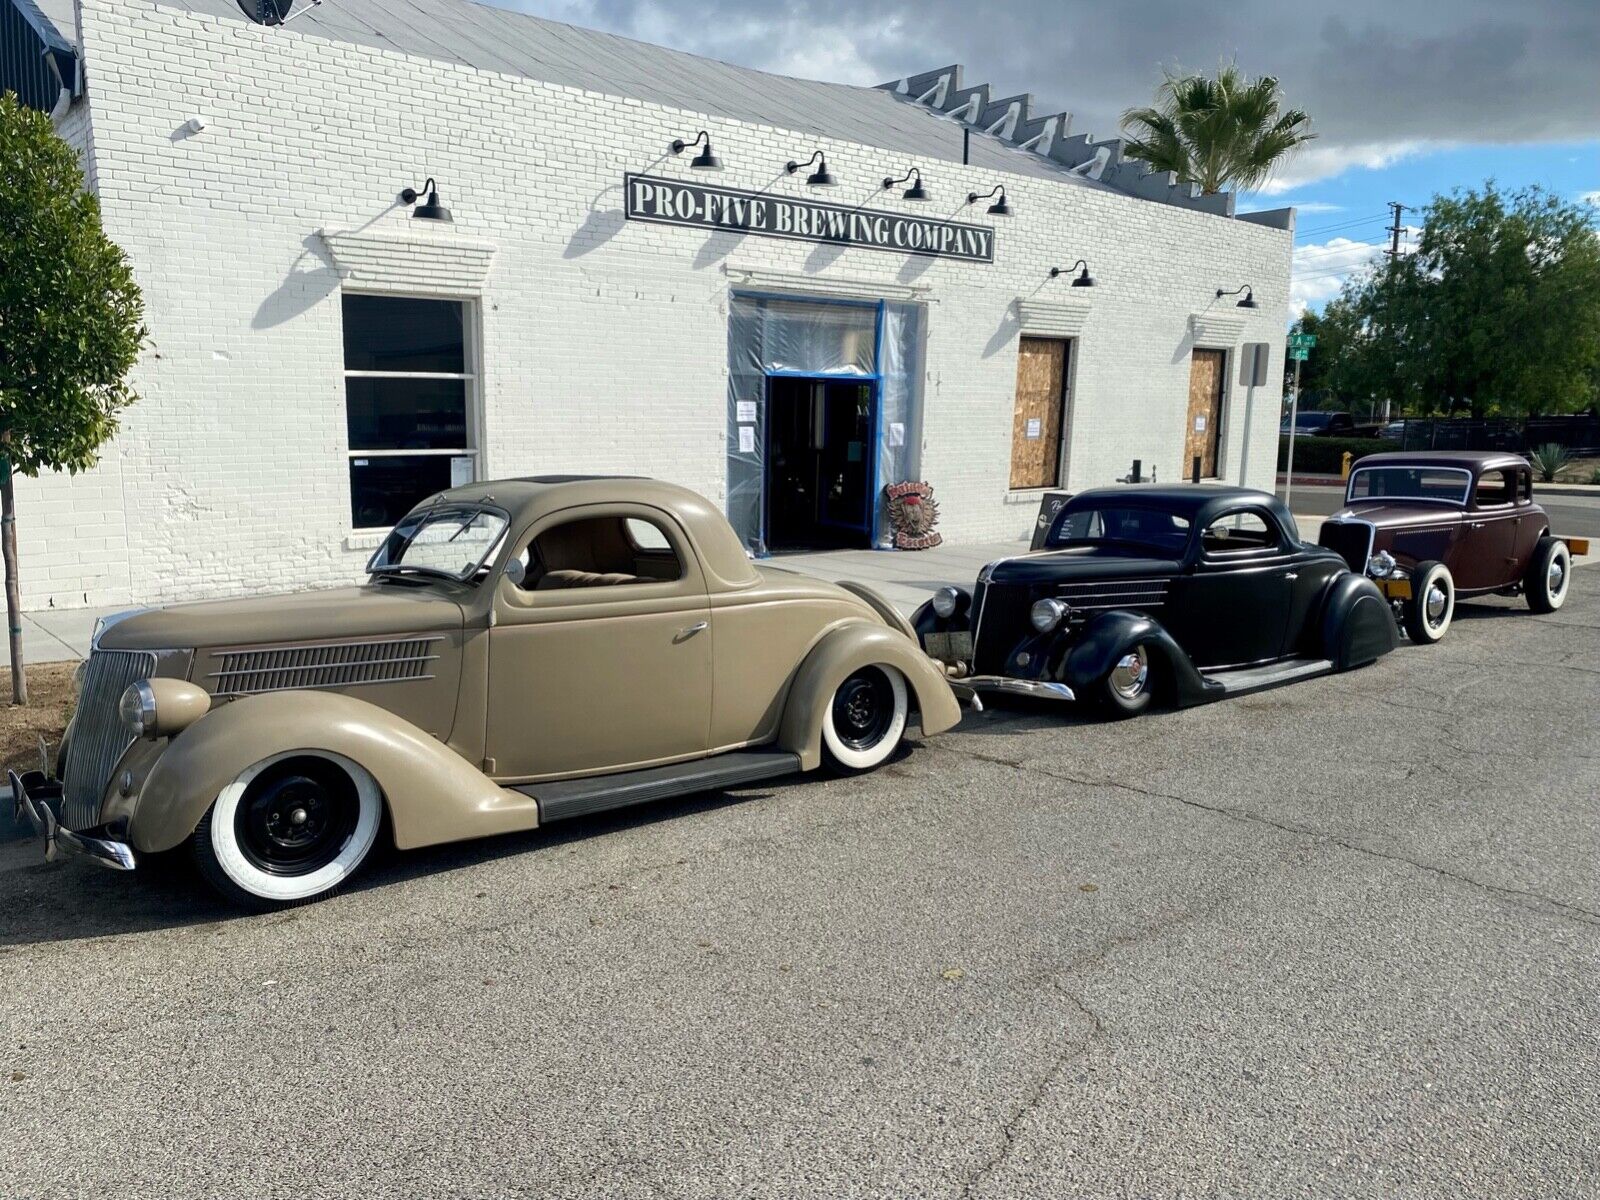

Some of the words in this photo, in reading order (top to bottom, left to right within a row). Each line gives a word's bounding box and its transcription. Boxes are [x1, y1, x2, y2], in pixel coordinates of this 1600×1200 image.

[633, 182, 767, 229] PRO-FIVE
[774, 202, 890, 244] BREWING
[894, 220, 990, 257] COMPANY
